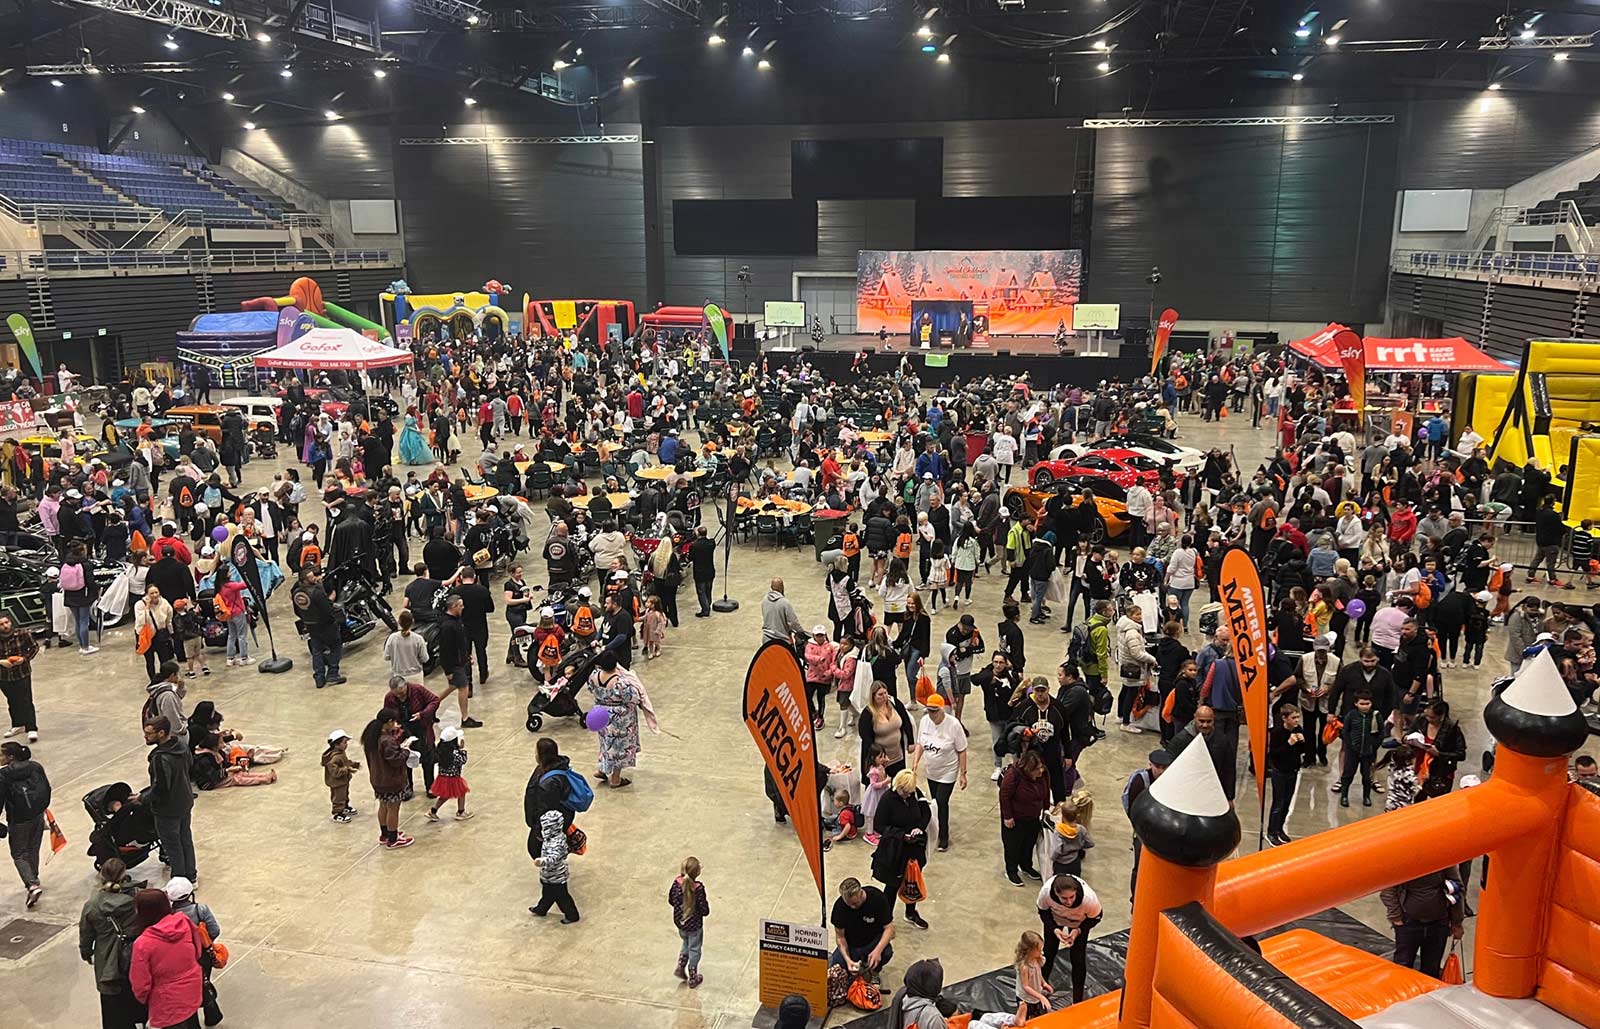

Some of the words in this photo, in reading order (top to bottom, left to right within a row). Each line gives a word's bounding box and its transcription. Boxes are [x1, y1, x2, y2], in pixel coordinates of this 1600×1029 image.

[280, 317, 296, 327] sky
[1158, 320, 1174, 331] sky
[15, 326, 30, 336] sky
[1340, 348, 1363, 359] sky
[1376, 342, 1429, 362] rrt
[1241, 586, 1262, 641] MITRE
[1255, 642, 1267, 667] 10
[1222, 577, 1258, 693] MEGA
[774, 681, 803, 734] MITRE
[798, 723, 812, 751] 10
[750, 687, 803, 801] MEGA
[767, 927, 788, 937] MEGA
[794, 929, 822, 938] HORNBY
[794, 935, 822, 946] PAPANUI
[763, 943, 784, 951] BOUNCY
[784, 945, 803, 953] CASTLE
